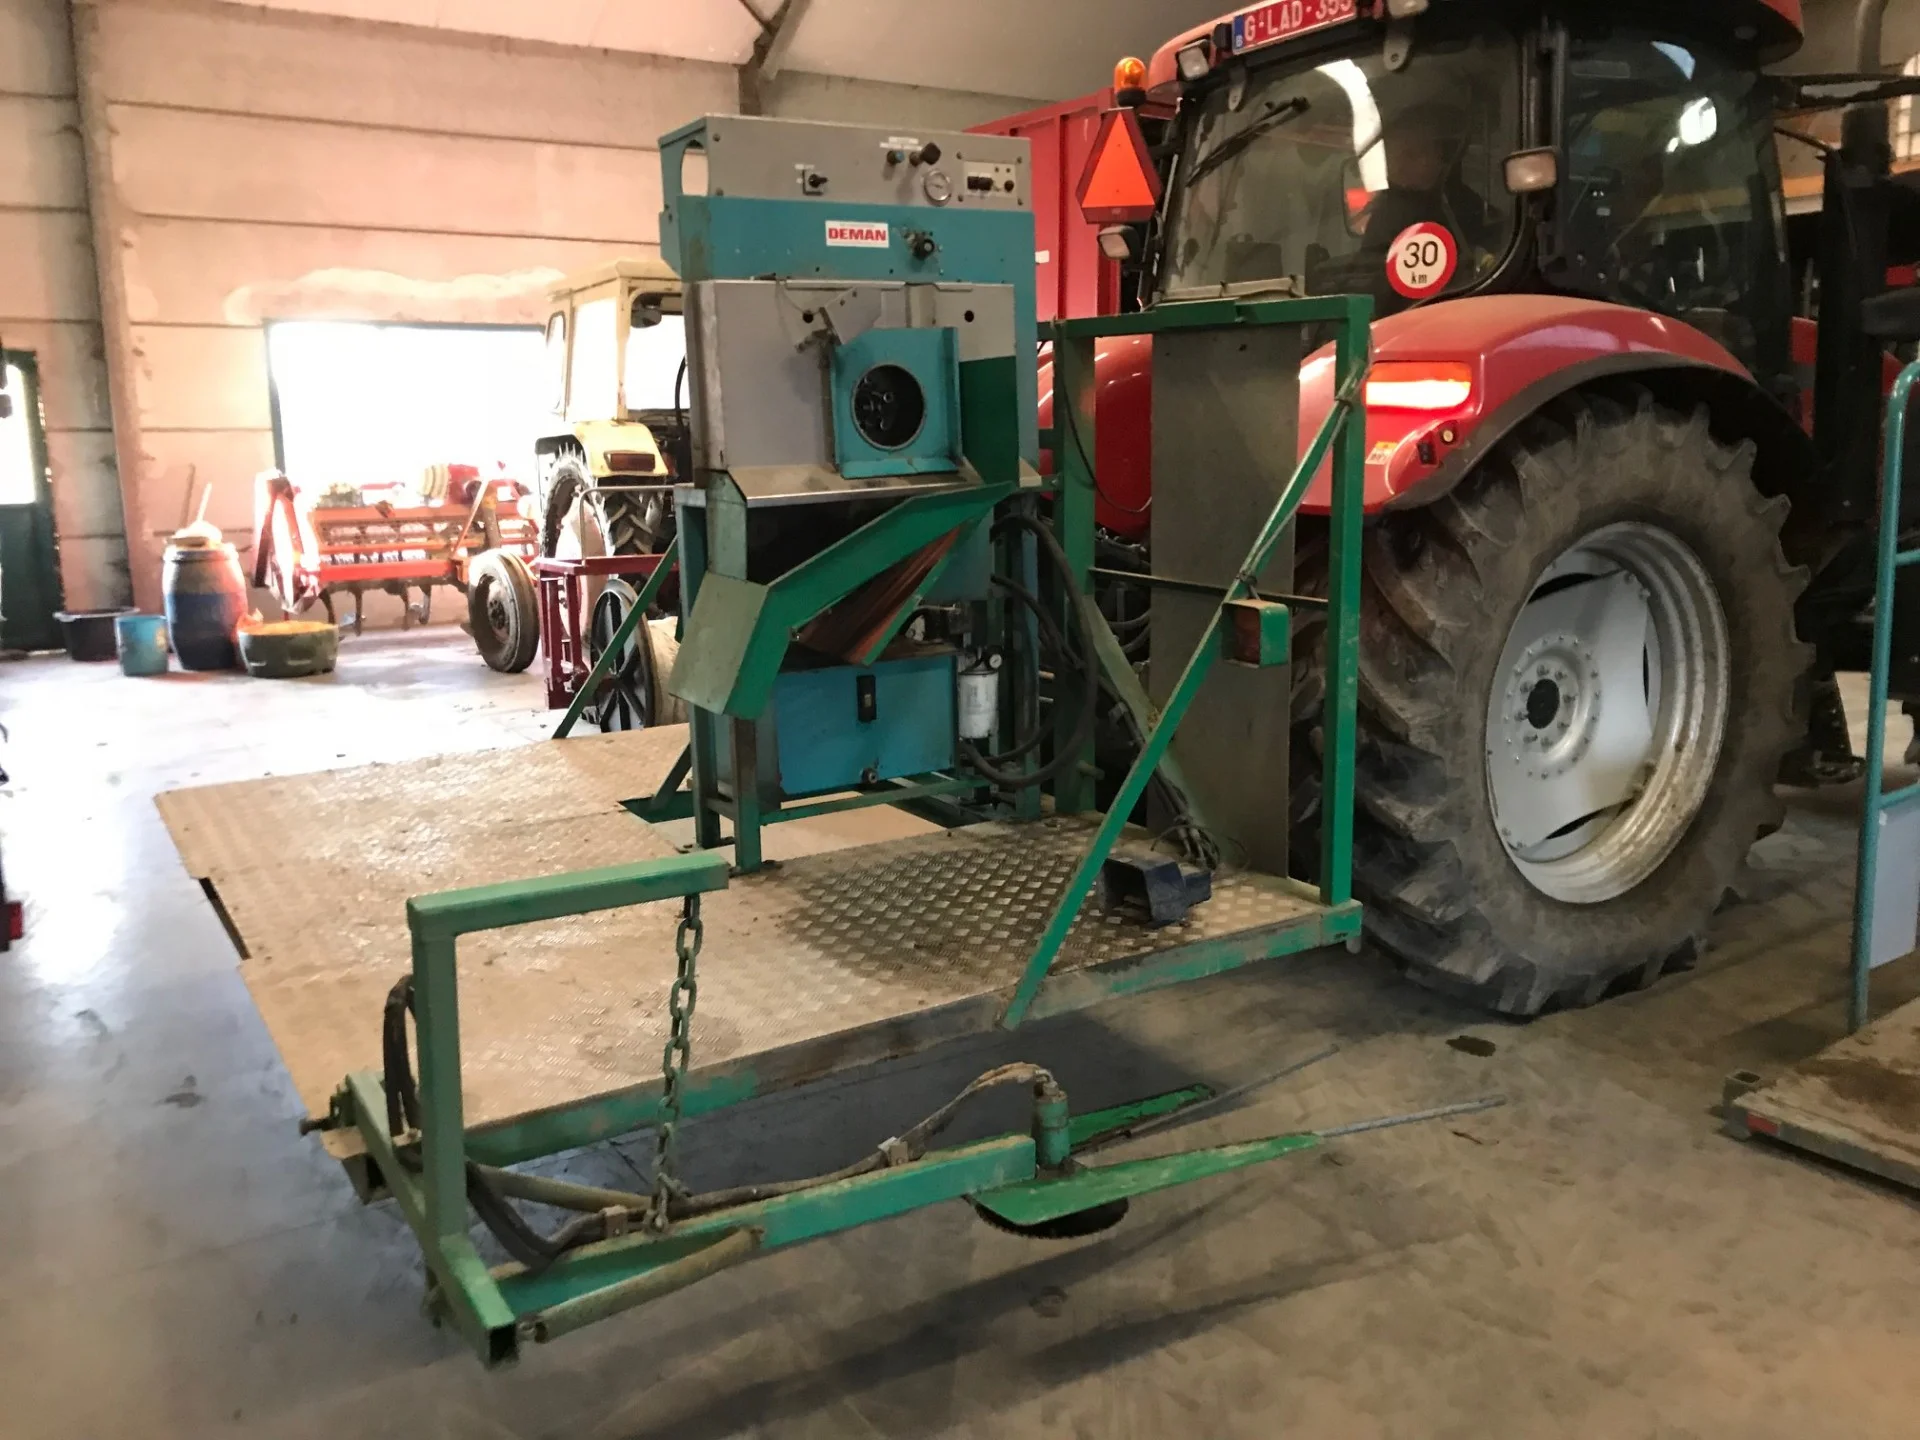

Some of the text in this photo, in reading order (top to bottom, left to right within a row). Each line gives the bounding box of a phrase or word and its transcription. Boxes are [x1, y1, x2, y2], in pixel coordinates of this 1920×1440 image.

[828, 227, 887, 241] DEMAN
[1403, 240, 1439, 269] 30
[1411, 271, 1428, 284] km
